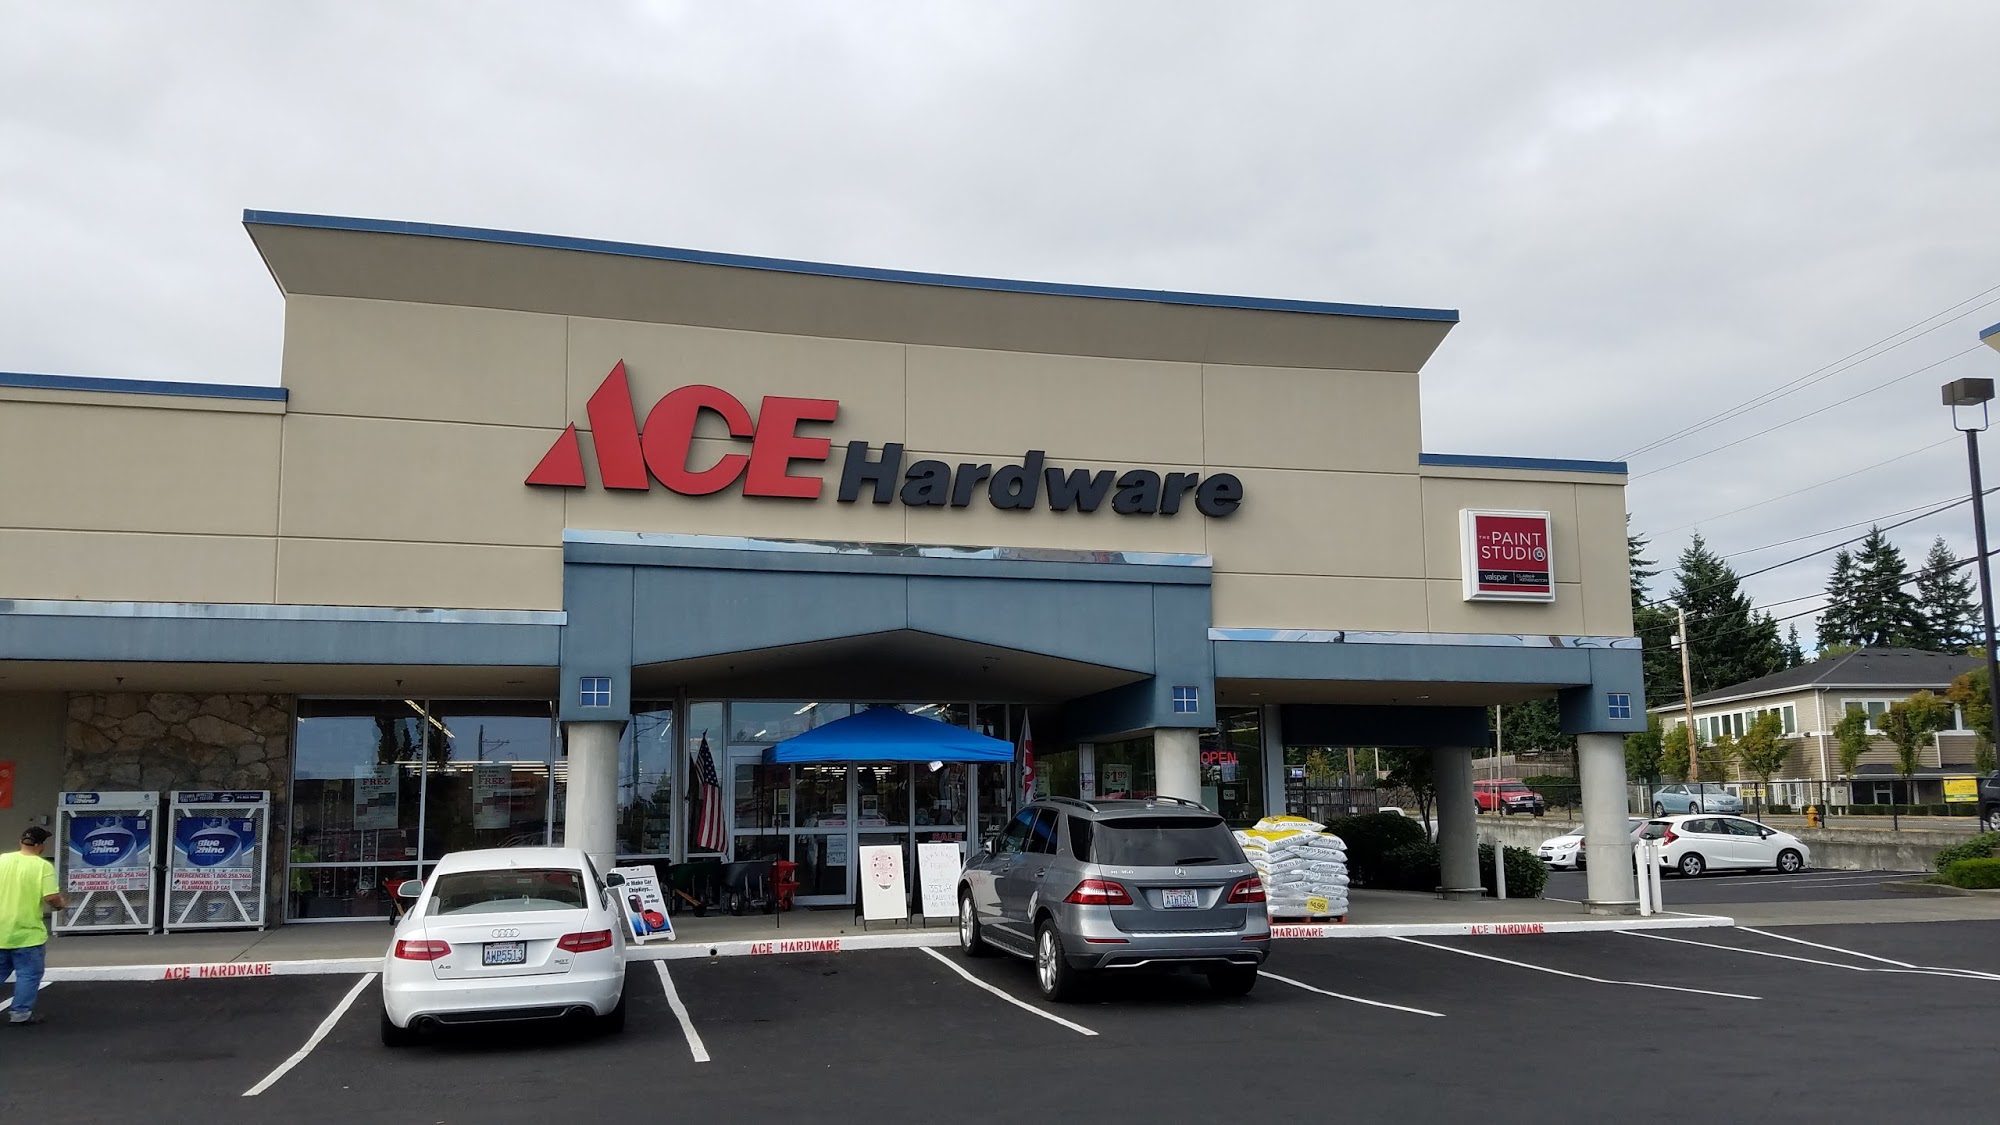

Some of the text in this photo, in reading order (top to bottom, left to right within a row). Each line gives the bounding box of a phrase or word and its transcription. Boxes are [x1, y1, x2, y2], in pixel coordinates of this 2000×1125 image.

[524, 358, 1244, 518] ACE Hardware
[1491, 531, 1542, 547] PAINT
[1481, 545, 1546, 562] STUDIO
[1484, 572, 1509, 582] valspar
[1200, 751, 1237, 766] OPEN
[362, 778, 391, 786] FREE
[478, 777, 505, 785] FREE
[198, 838, 220, 846] Blue
[932, 832, 962, 842] SALE
[1276, 860, 1294, 869] BEAUTY
[1272, 927, 1324, 937] HARDWARE
[1471, 923, 1545, 934] ACE HARDWARE
[751, 939, 841, 955] ACE HARDWARE
[164, 963, 272, 981] ACE HARDWARE
